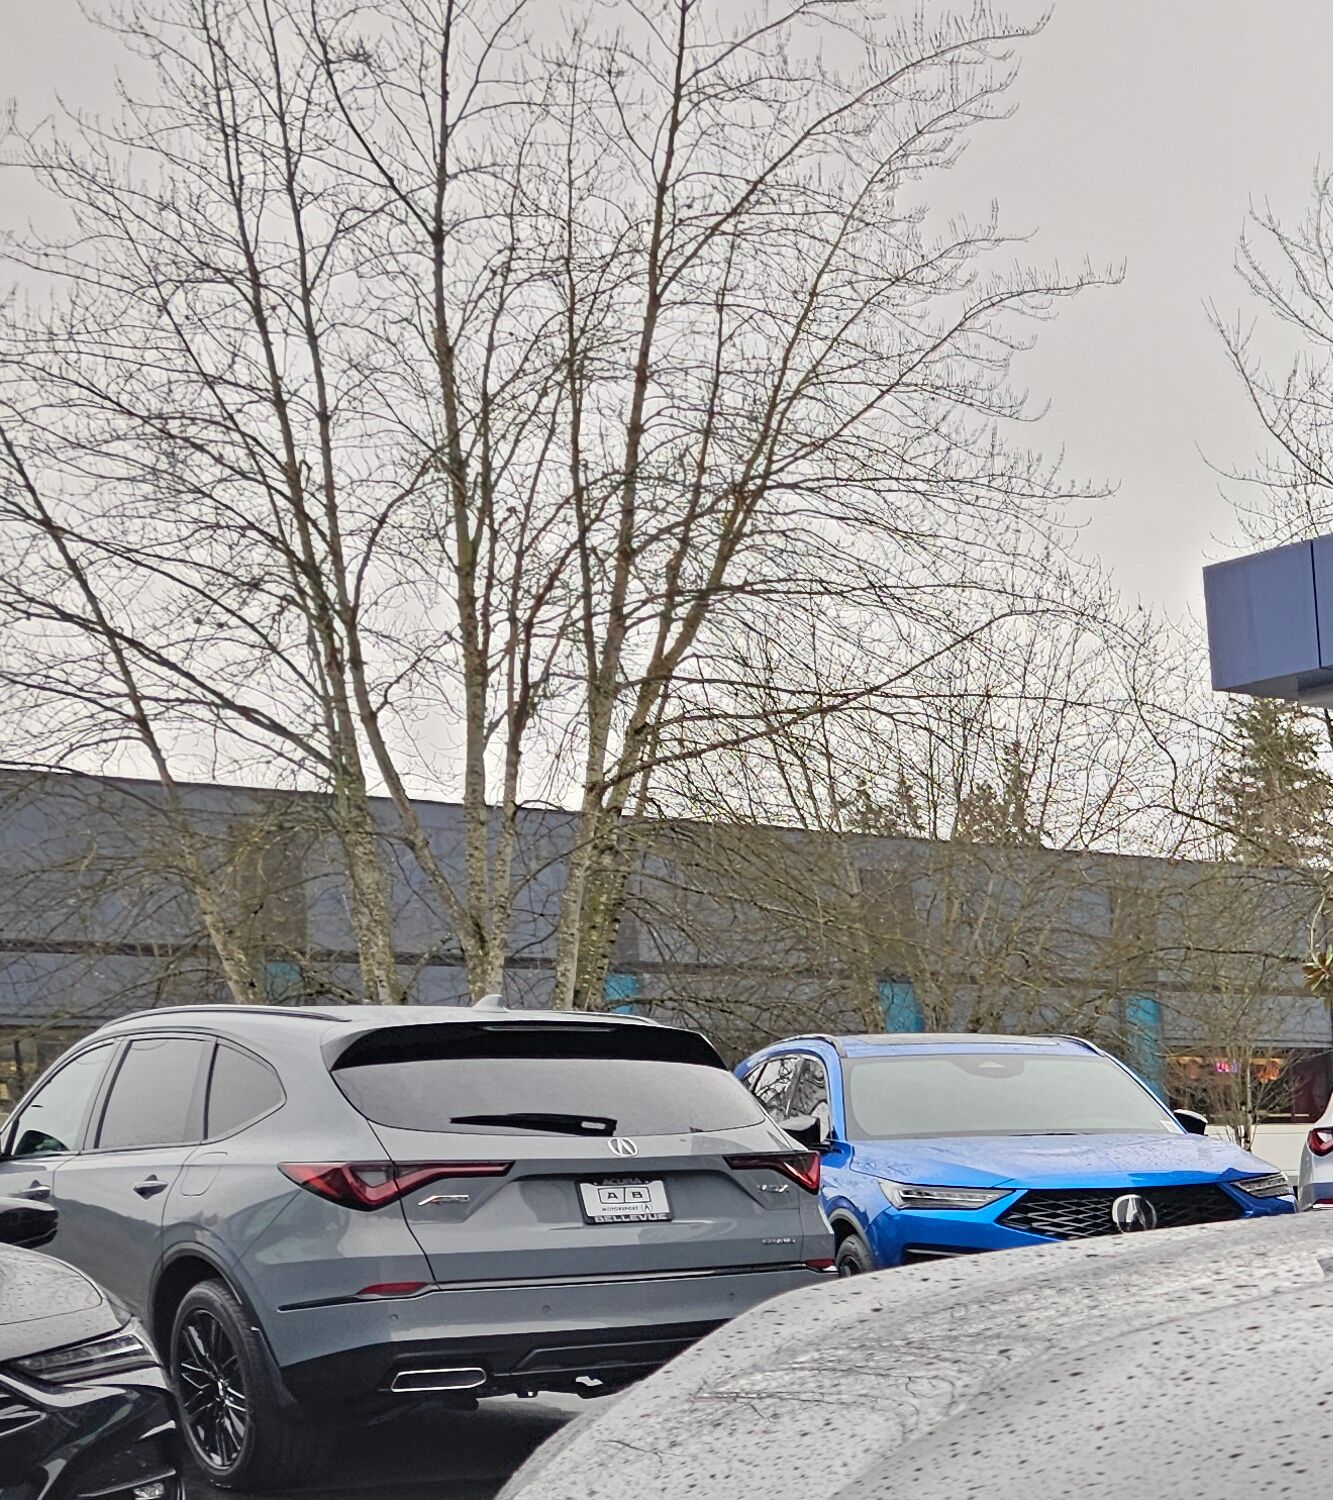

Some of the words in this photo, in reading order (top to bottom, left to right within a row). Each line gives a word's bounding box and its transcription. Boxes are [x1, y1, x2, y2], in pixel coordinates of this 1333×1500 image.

[607, 1192, 618, 1200] A
[631, 1191, 643, 1199] B
[594, 1213, 668, 1223] BELLEVUE
